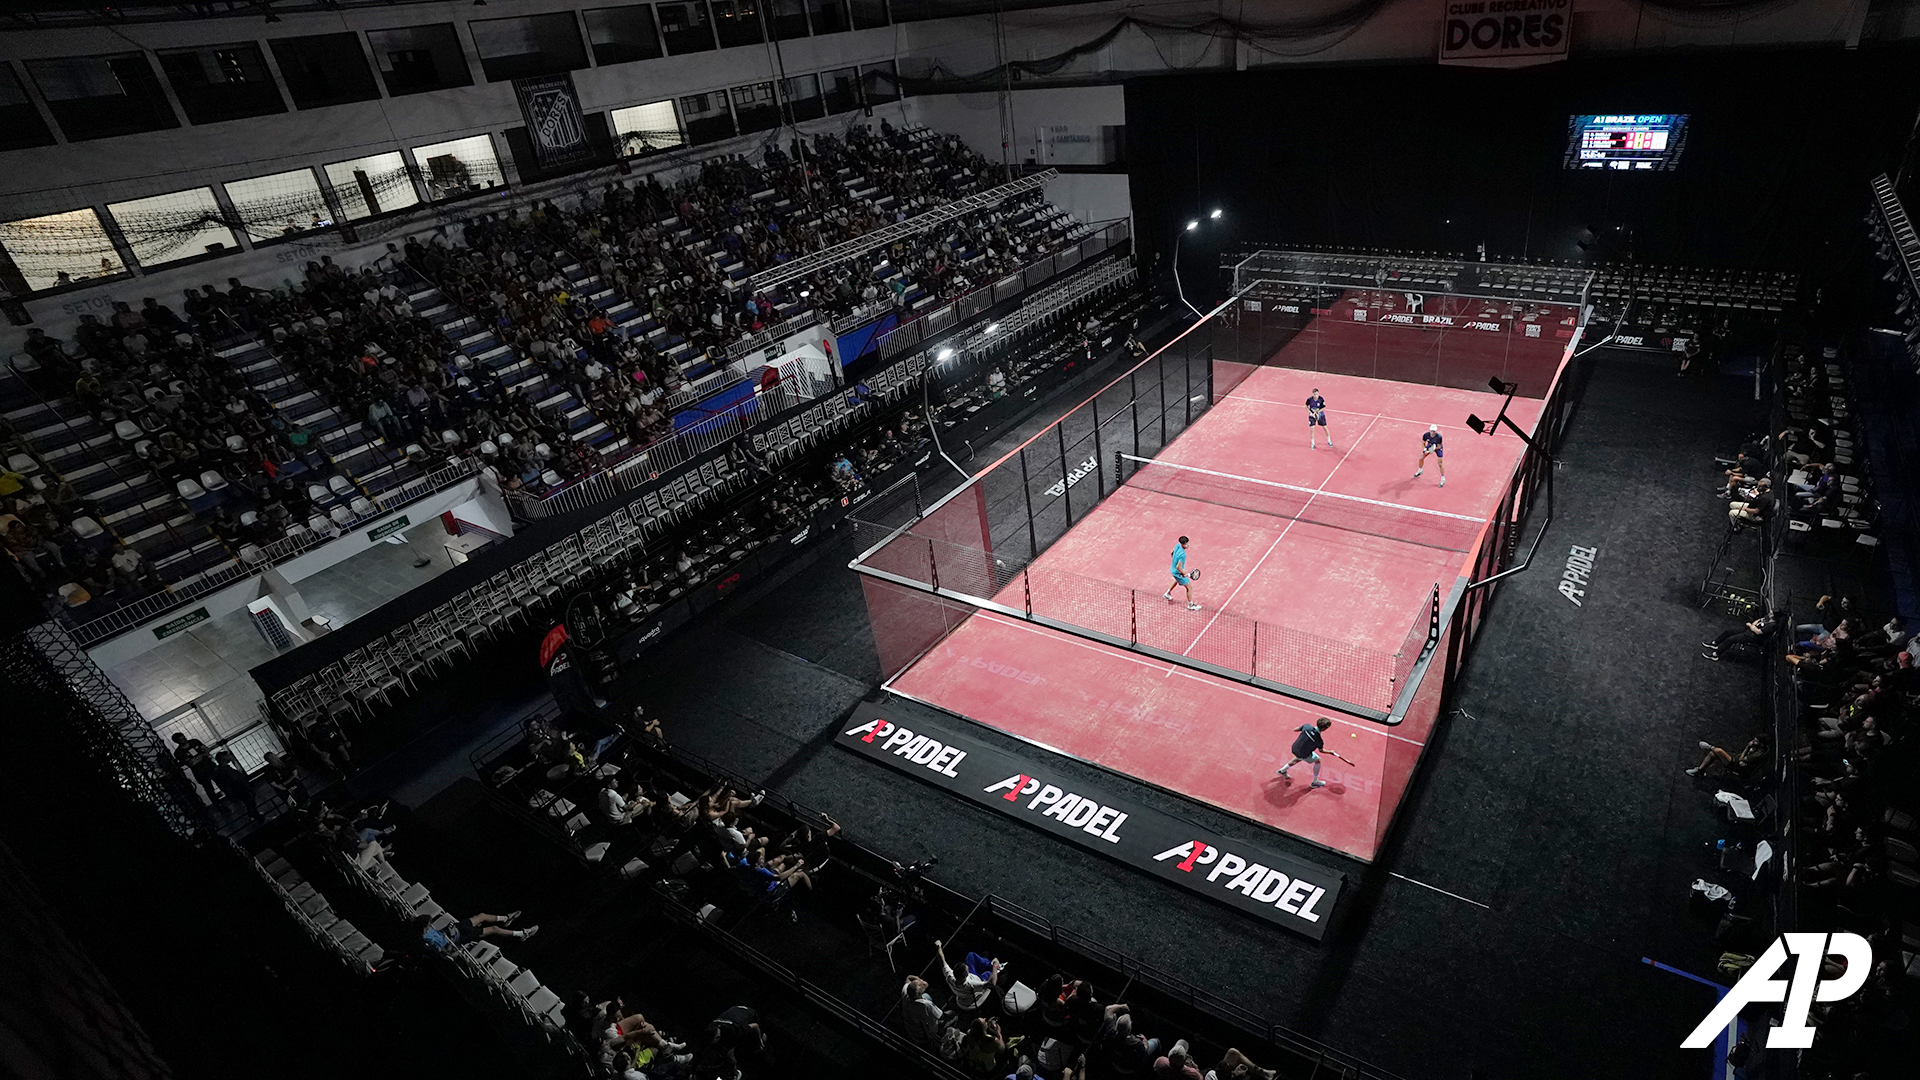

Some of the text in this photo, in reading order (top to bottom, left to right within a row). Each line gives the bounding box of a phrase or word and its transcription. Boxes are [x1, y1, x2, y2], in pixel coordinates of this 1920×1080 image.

[1449, 0, 1567, 15] CLUBE RECREATIVO
[1445, 14, 1564, 51] DORES
[542, 96, 567, 137] DORES
[1281, 305, 1300, 314] PADEL
[1391, 314, 1414, 324] PADEL
[1422, 315, 1455, 326] BRAZIL
[1474, 322, 1501, 332] PADEL
[1615, 335, 1644, 346] PADEL
[1562, 544, 1598, 586] PADEL
[550, 661, 572, 677] PADEL
[881, 727, 968, 779] PADEL
[1027, 784, 1129, 844] PADEL
[1205, 852, 1327, 923] PADEL
